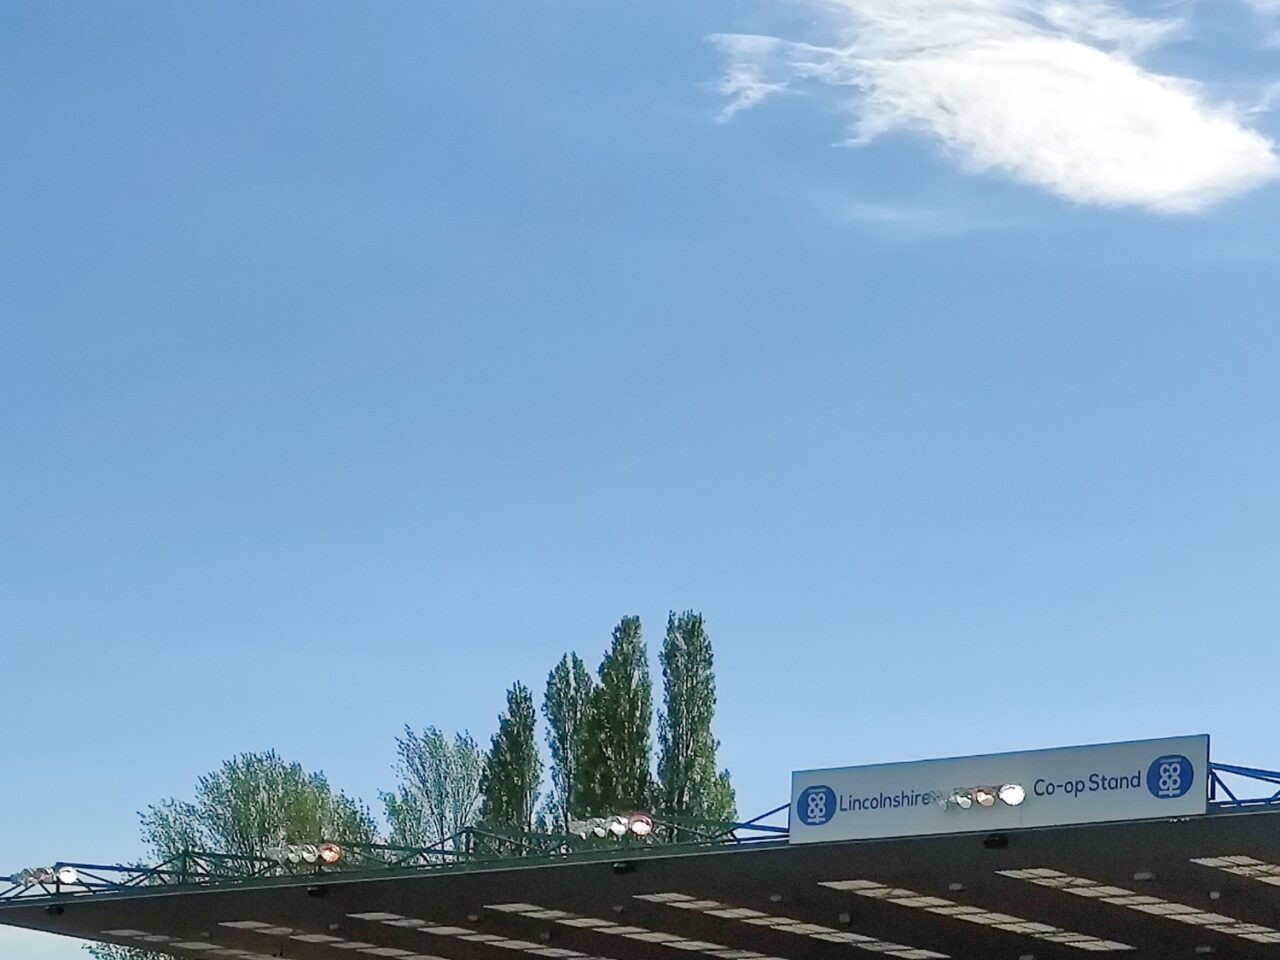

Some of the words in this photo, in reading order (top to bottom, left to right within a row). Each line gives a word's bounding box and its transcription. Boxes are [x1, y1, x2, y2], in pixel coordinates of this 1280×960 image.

[839, 790, 931, 812] Lincolnshire
[1033, 777, 1086, 800] Co-op
[1088, 769, 1141, 792] Stand
